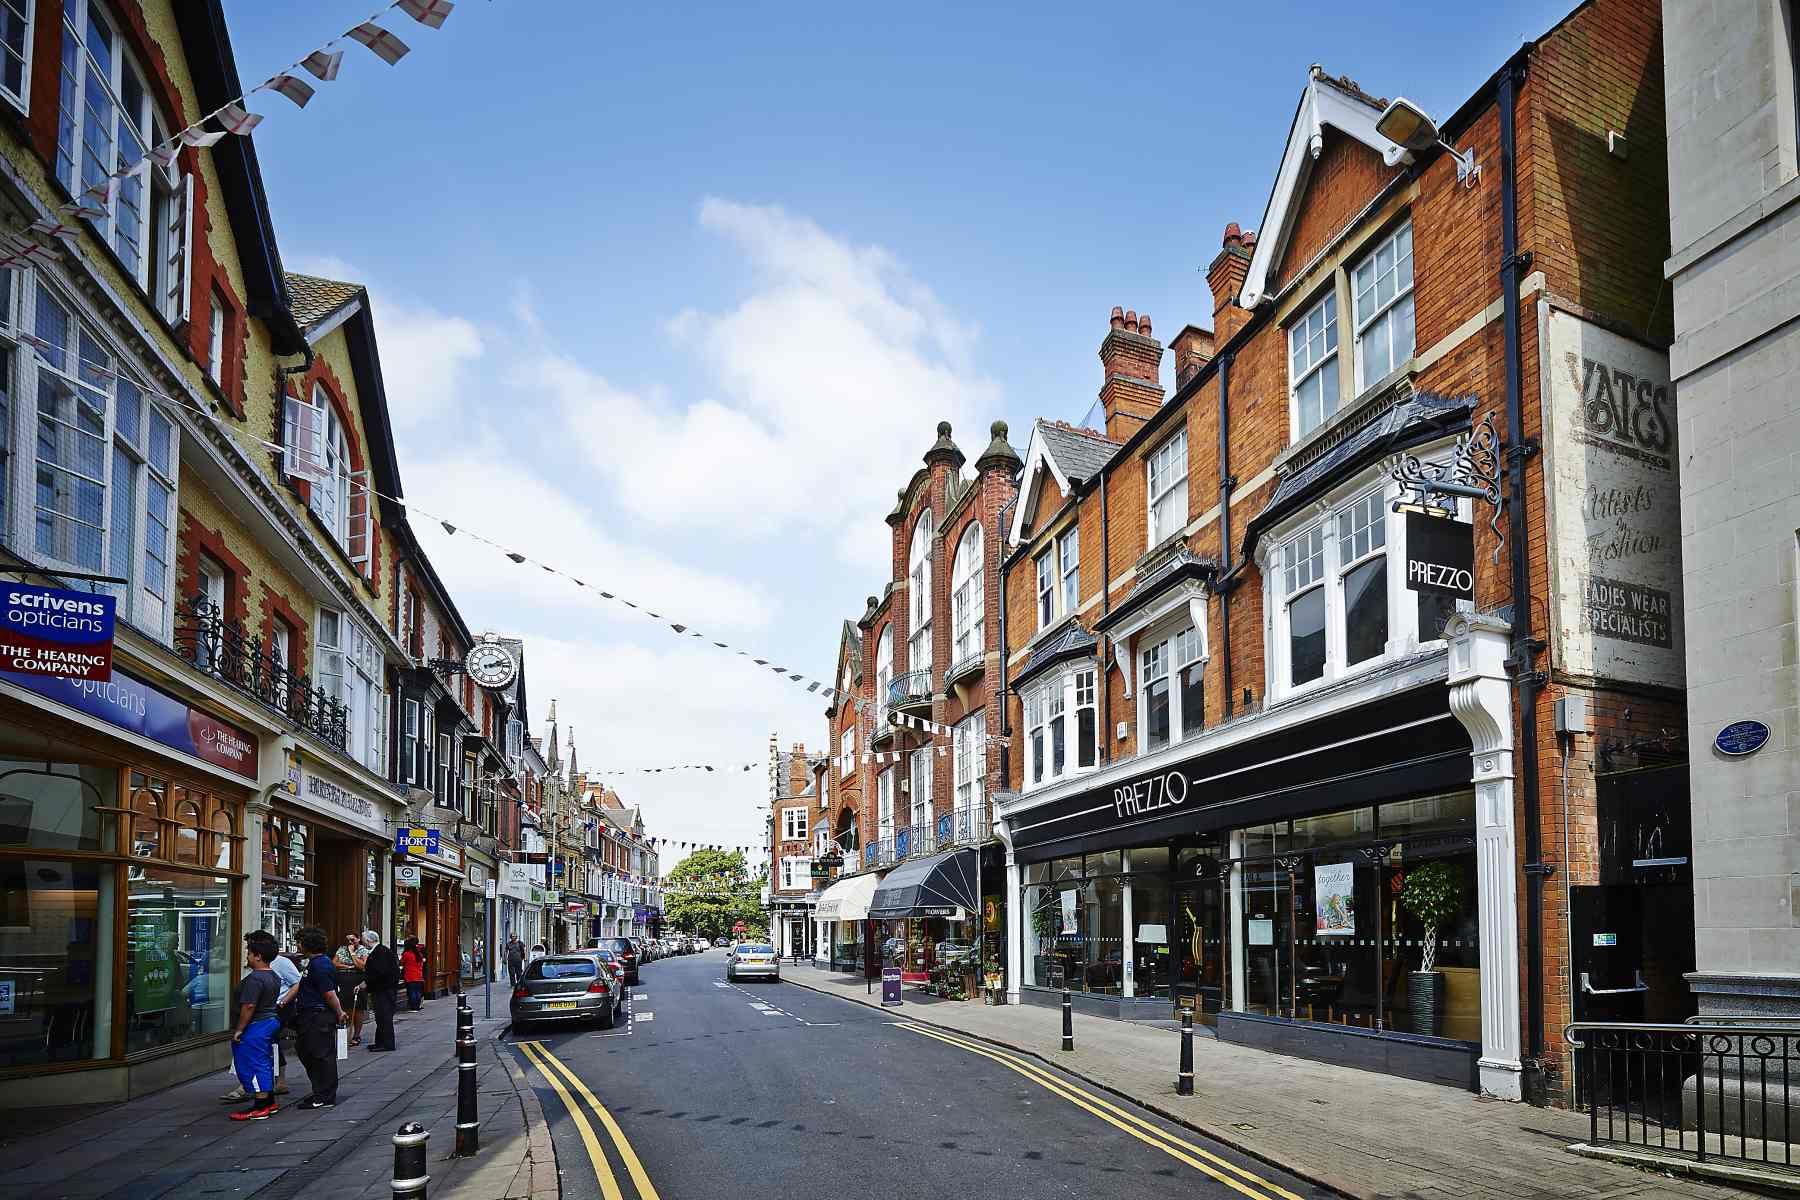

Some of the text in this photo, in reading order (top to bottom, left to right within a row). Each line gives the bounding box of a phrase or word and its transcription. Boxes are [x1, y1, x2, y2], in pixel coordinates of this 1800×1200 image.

[1409, 559, 1473, 591] PREZZO
[8, 592, 104, 616] scrivens
[1583, 578, 1667, 616] LADIES WEAR
[8, 609, 103, 632] opticians
[1583, 606, 1667, 641] SPECIALISTS
[0, 644, 105, 666] THE HEARING
[13, 658, 91, 676] COMPANY
[216, 729, 252, 755] THE HEARING
[216, 742, 243, 762] COMPANY
[1114, 771, 1187, 818] PREZZO
[399, 836, 438, 847] HORTS
[1196, 863, 1202, 876] 2
